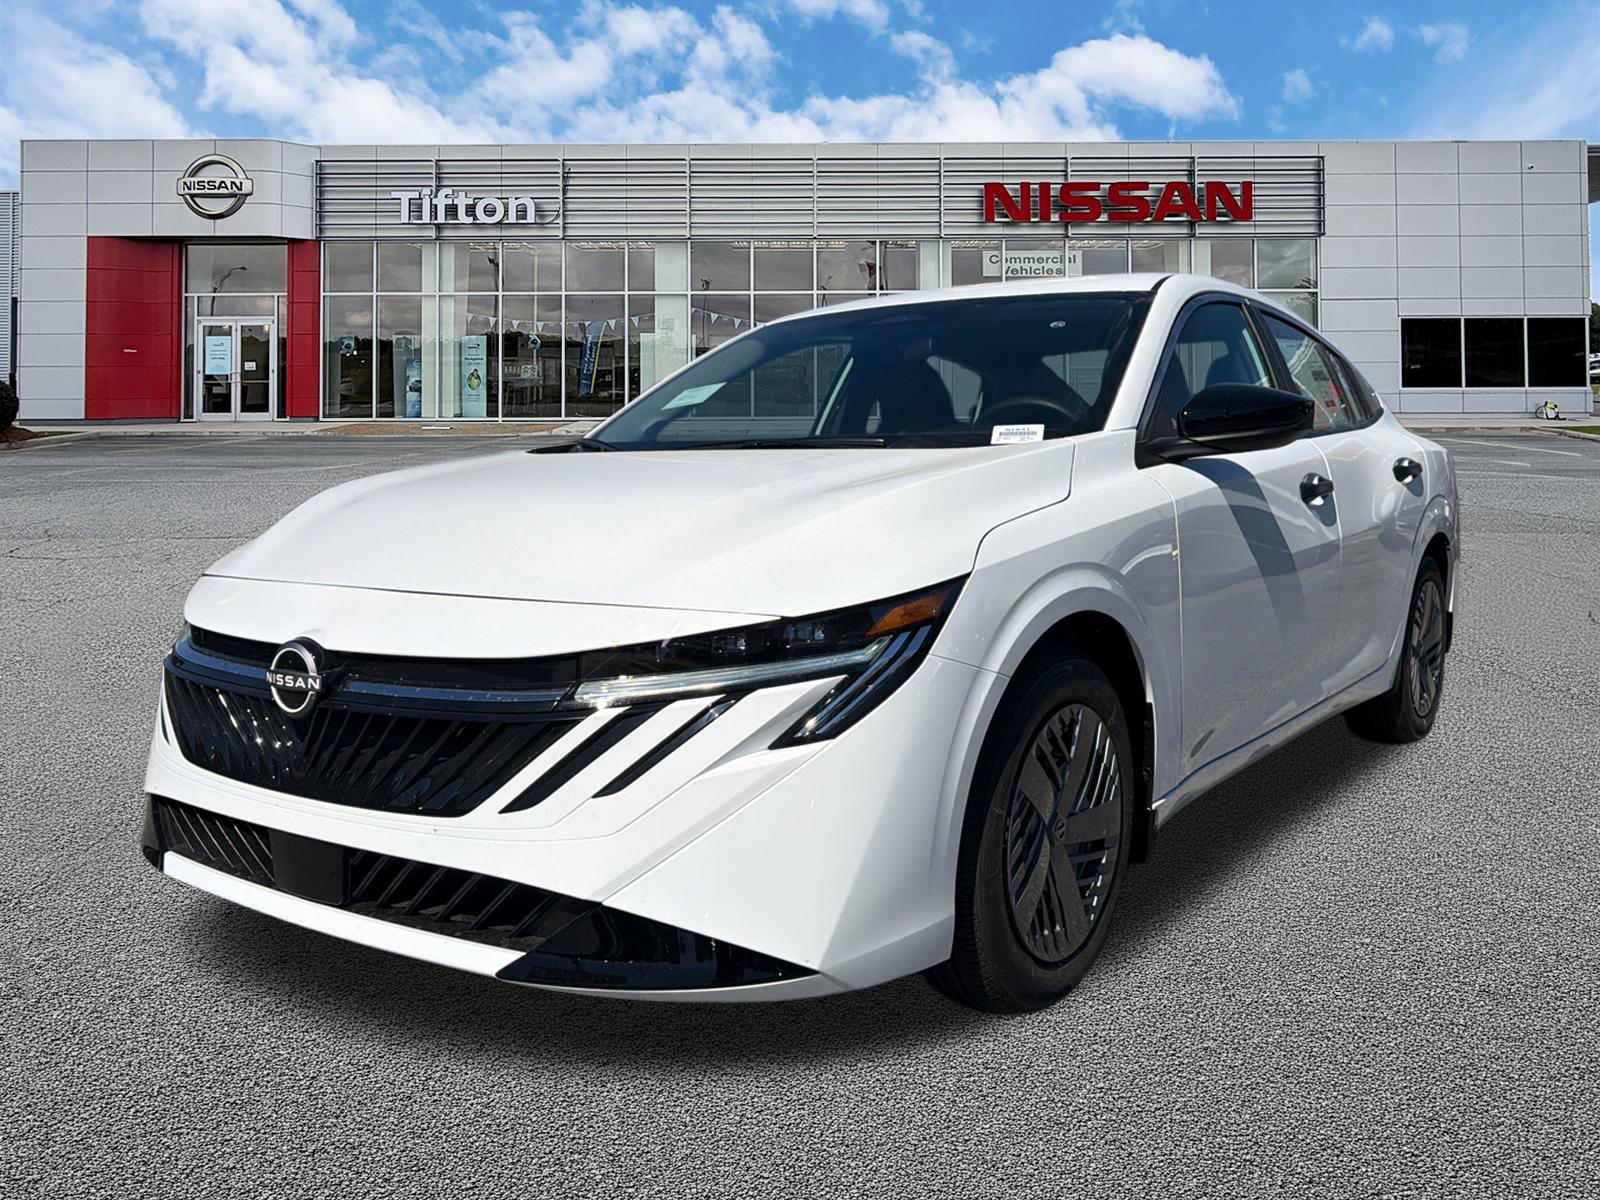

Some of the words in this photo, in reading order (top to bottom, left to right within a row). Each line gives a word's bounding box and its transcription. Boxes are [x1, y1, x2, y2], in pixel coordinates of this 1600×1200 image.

[183, 180, 243, 192] NISSAN
[391, 188, 536, 225] Tifton
[983, 181, 1254, 223] NISSAN
[988, 254, 1076, 265] Cmmercil
[266, 671, 320, 690] NISSAN
